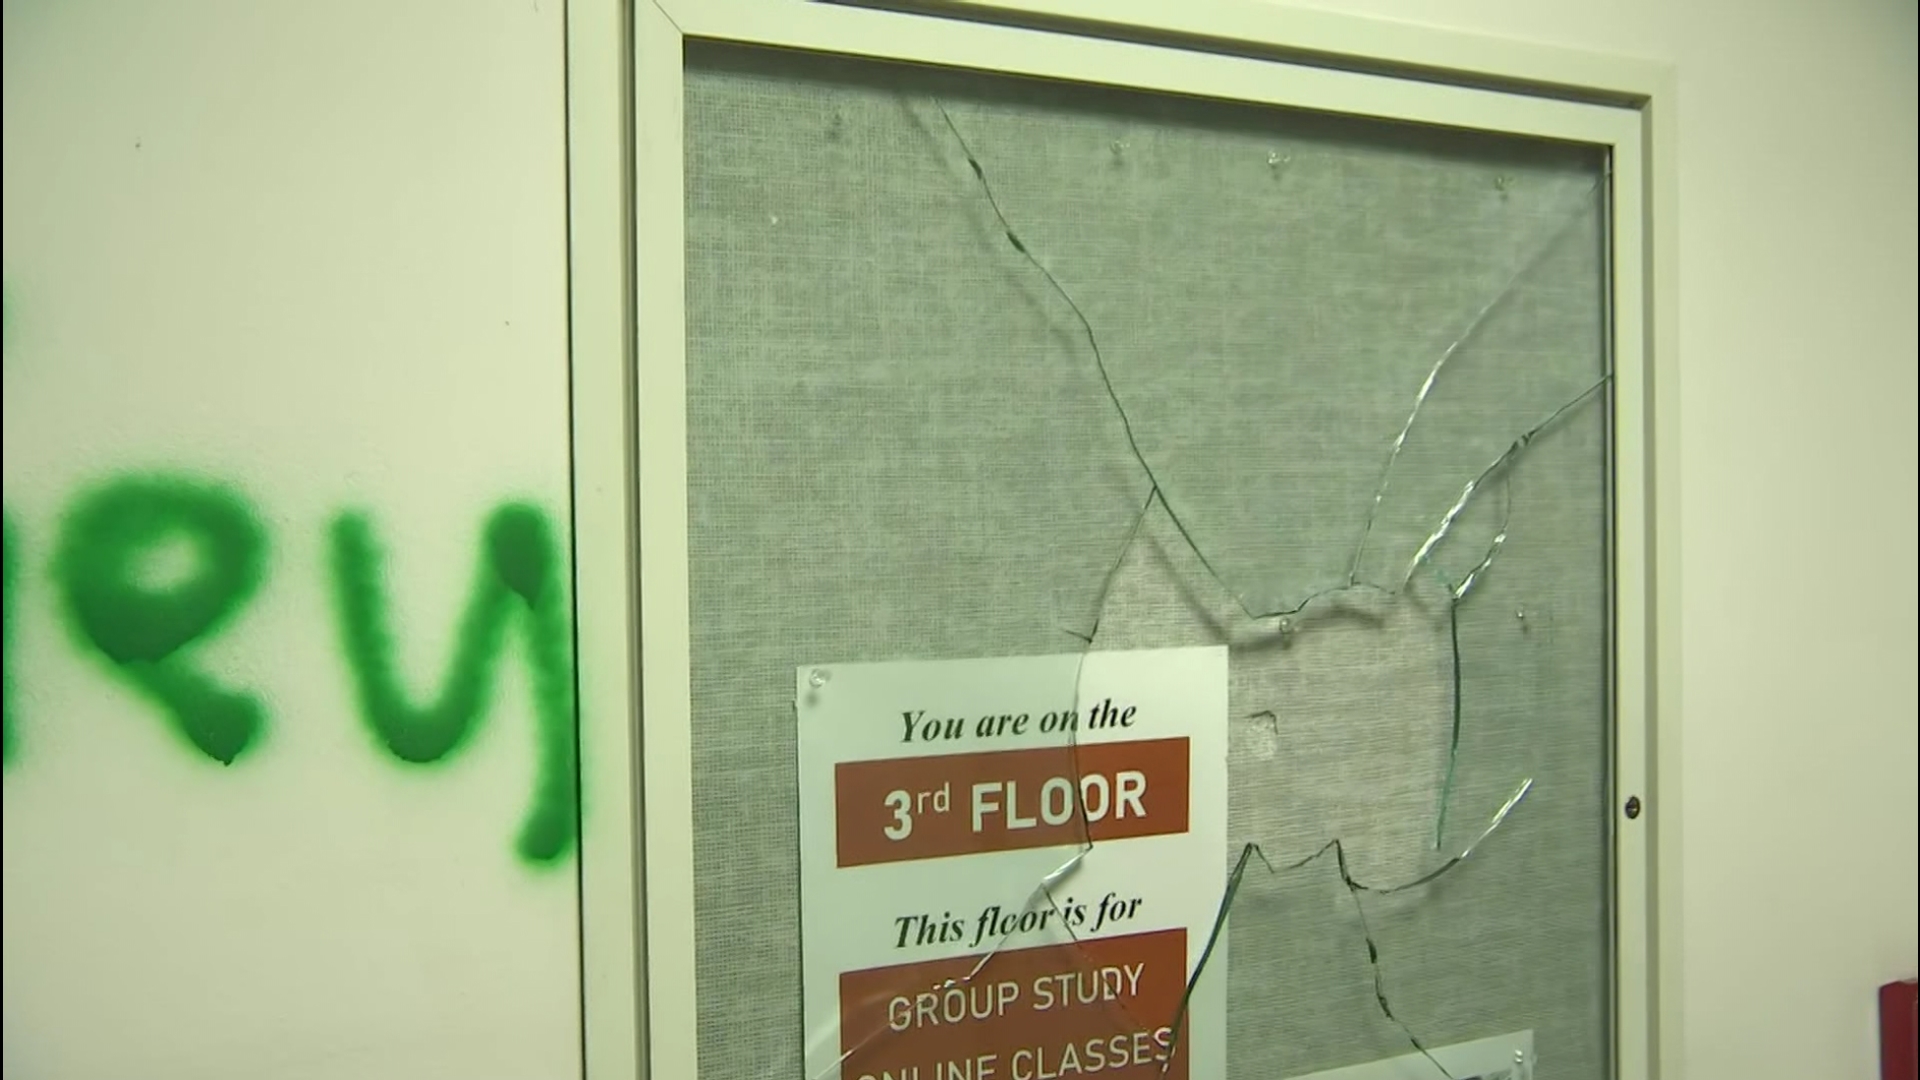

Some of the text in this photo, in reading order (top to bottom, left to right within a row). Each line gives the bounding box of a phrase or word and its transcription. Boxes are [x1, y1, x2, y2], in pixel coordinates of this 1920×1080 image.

[3, 470, 580, 862] ey
[900, 698, 1137, 742] You are on the
[883, 770, 1147, 841] 3rd FLOOR
[894, 912, 964, 948] This
[1064, 897, 1087, 926] is
[1090, 892, 1142, 932] for
[888, 962, 1145, 1031] GROUP STUDY
[1012, 1027, 1176, 1080] CLASSES
